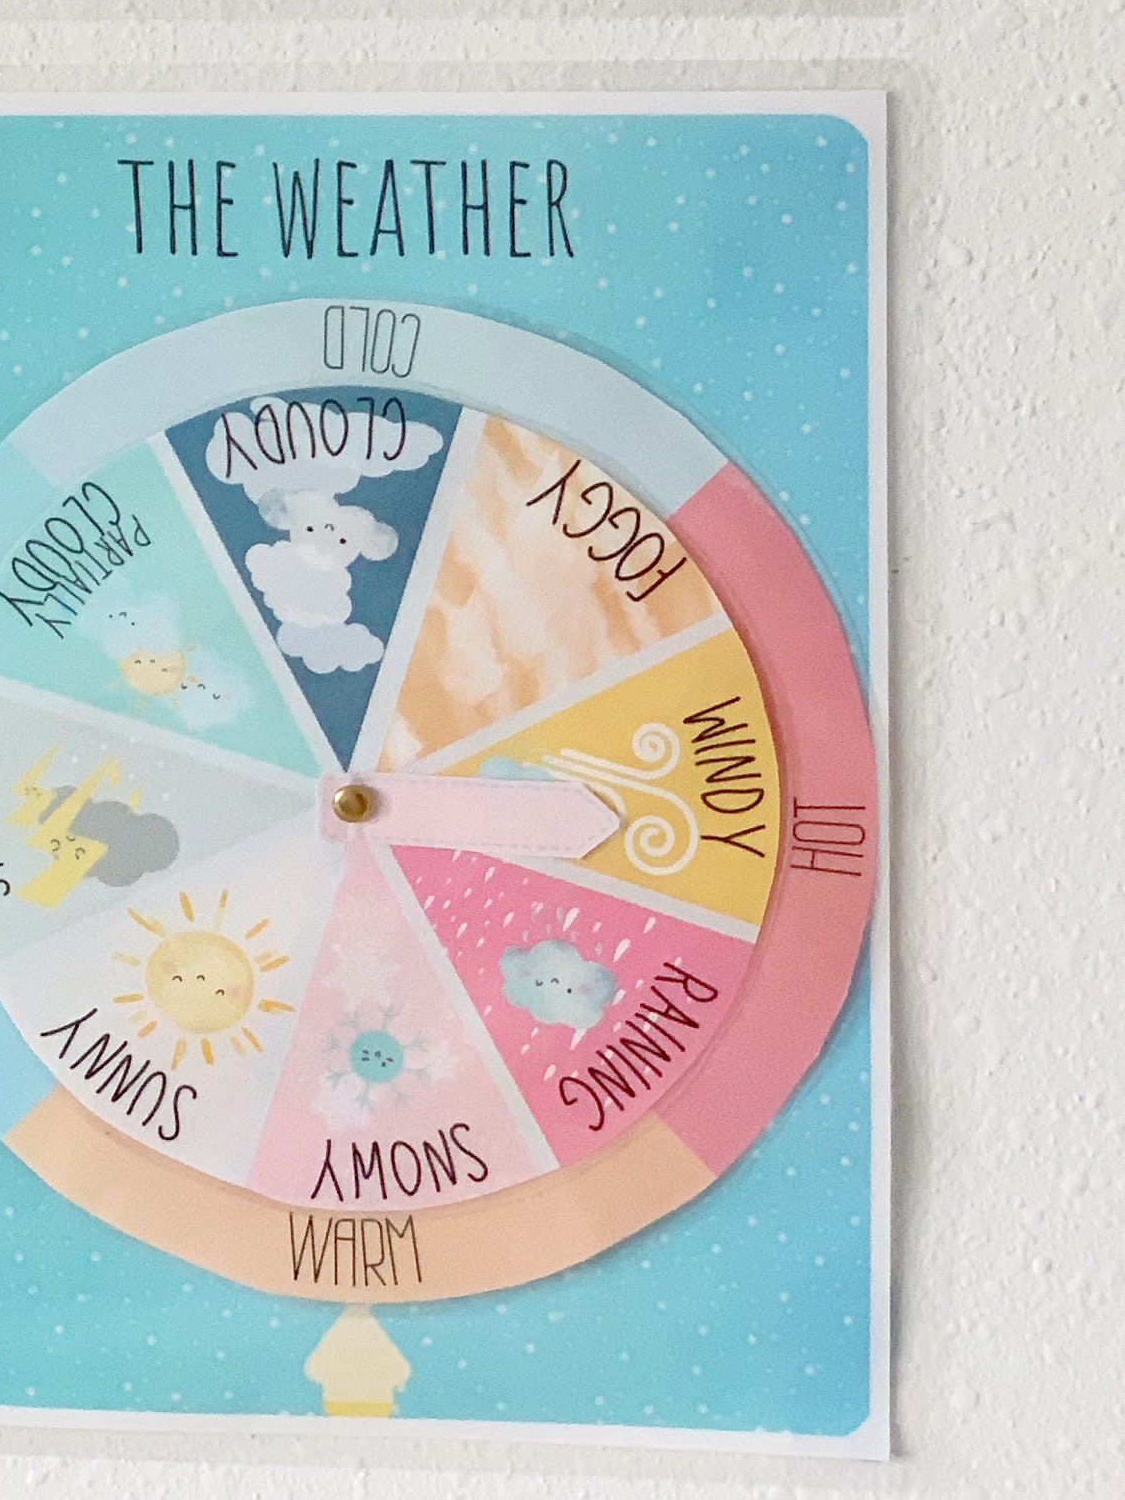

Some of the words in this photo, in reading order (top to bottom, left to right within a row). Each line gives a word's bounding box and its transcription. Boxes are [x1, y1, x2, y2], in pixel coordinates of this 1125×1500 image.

[118, 158, 239, 257] THE
[274, 158, 576, 259] WEATHER
[322, 304, 421, 379] COLD
[220, 396, 407, 479] CLOUDY
[40, 513, 153, 640] PARTIALLY
[526, 458, 687, 603] FOGGY
[683, 695, 767, 859] WINDY
[789, 795, 868, 878] HOT
[39, 1006, 199, 1142] SUNNY
[558, 961, 720, 1132] RAINING
[310, 1122, 490, 1203] SNOWY
[288, 1212, 423, 1287] WARM
